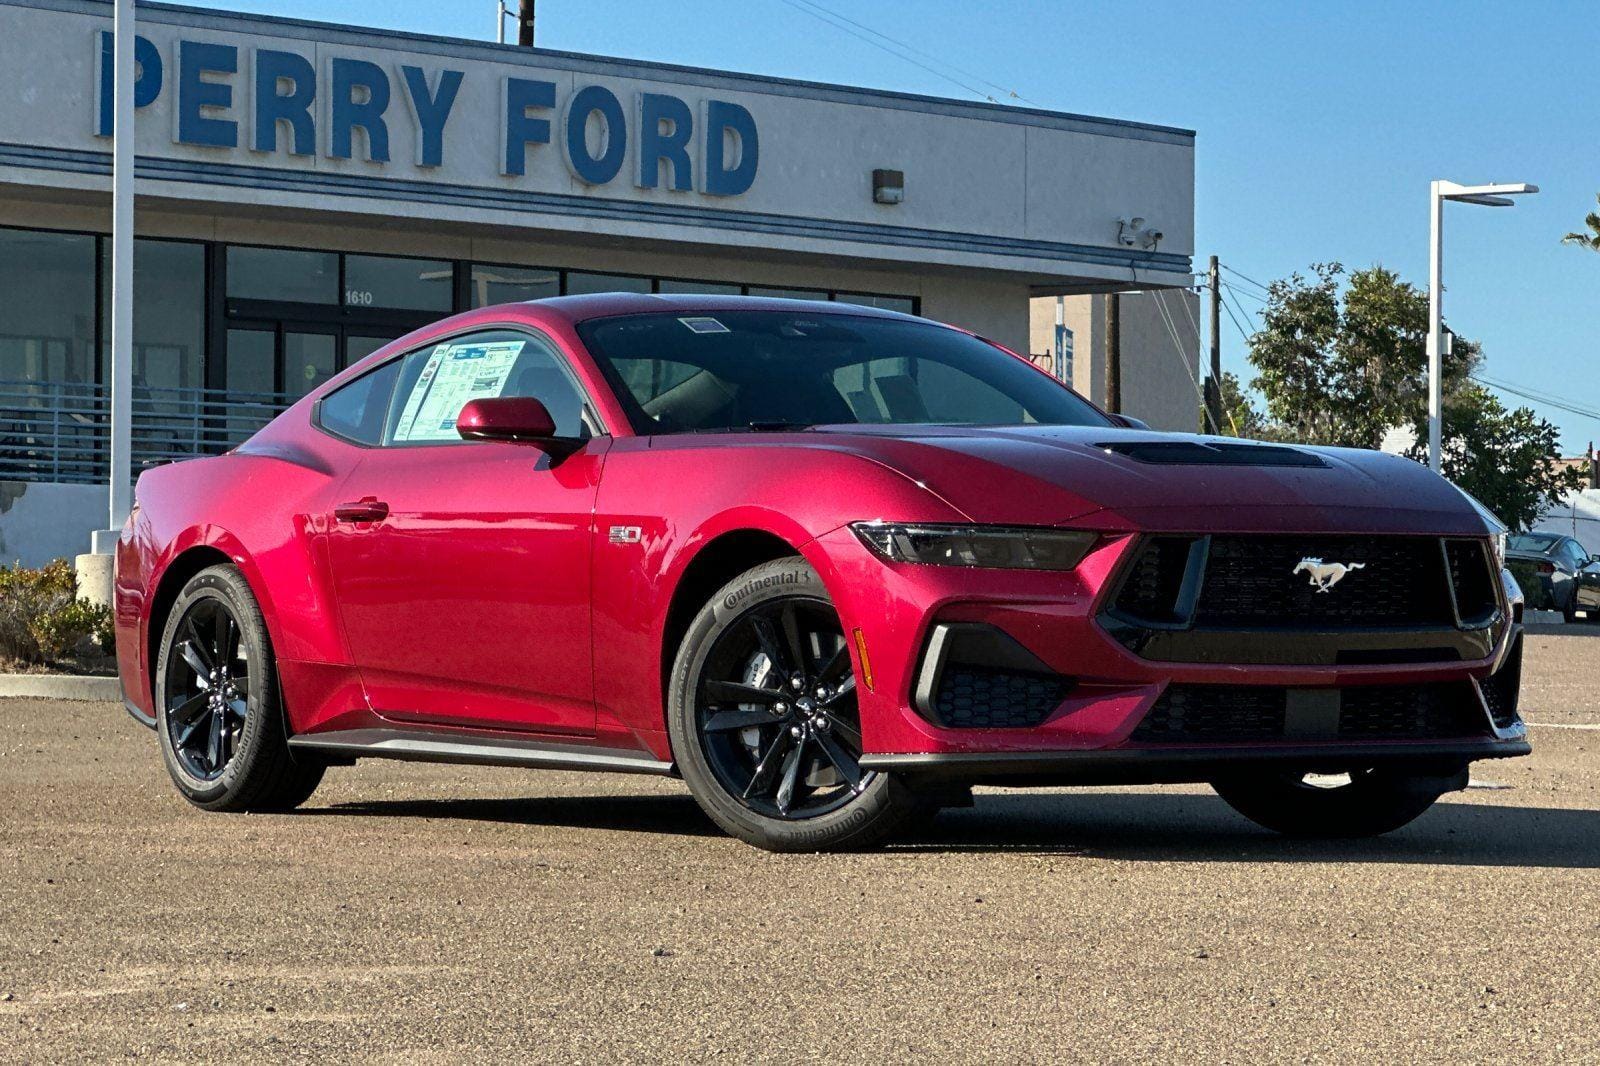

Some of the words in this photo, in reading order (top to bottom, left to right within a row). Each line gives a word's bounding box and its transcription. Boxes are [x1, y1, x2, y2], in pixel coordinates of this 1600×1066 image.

[95, 31, 464, 167] PERRY
[501, 76, 759, 196] FORD
[345, 290, 373, 305] 1610
[723, 570, 799, 610] Continental
[232, 709, 255, 776] Continental
